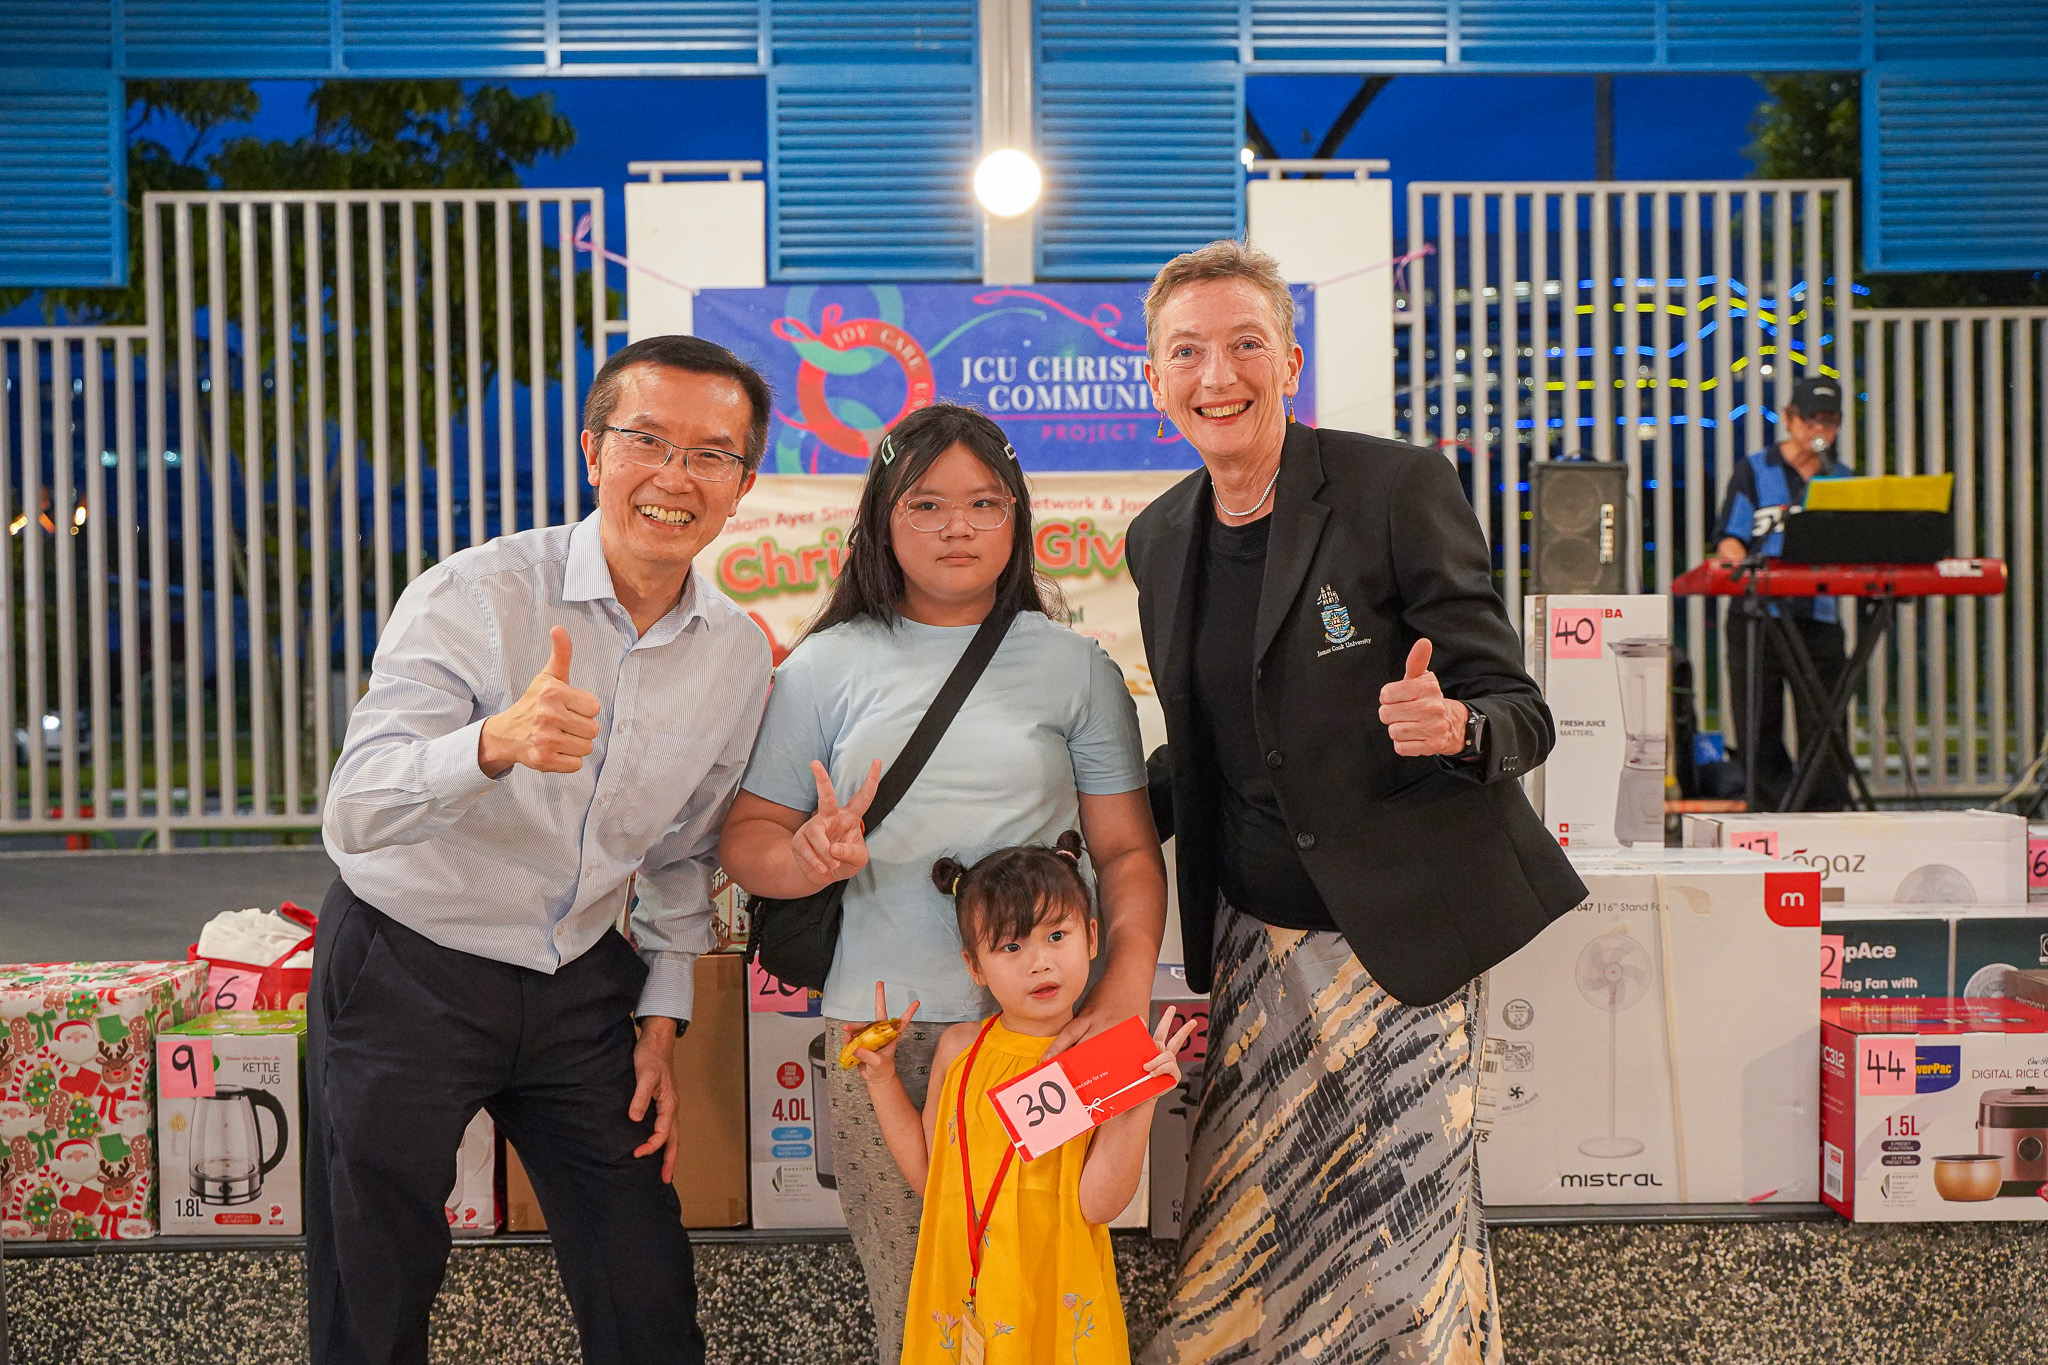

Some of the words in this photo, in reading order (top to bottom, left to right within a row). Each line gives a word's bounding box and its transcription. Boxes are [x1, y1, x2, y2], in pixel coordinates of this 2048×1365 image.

[833, 324, 868, 348] JOY
[880, 328, 924, 370] CARE
[961, 356, 1017, 388] JCU
[1041, 423, 1138, 444] PROJECT
[1030, 496, 1095, 511] etwork
[1102, 498, 1114, 510] &
[723, 516, 770, 535] olam
[775, 511, 814, 532] Ayer
[1555, 617, 1595, 646] 40
[1317, 649, 1331, 657] James
[1332, 643, 1344, 651] Cook
[1345, 638, 1371, 648] University
[1560, 720, 1584, 728] FRESH
[1585, 720, 1606, 728] JUICE
[1620, 902, 1649, 912] Stand
[1840, 942, 1897, 963] pAce
[215, 975, 238, 1010] 6
[1840, 978, 1863, 993] ing
[1865, 977, 1888, 990] Fan
[1891, 976, 1919, 989] with
[172, 1045, 198, 1089] 9
[242, 1062, 280, 1073] KETTLE
[1867, 1049, 1906, 1085] 44
[1972, 1069, 2012, 1079] DIGITAL
[2016, 1069, 2040, 1079] RICE
[260, 1074, 281, 1084] JUG
[772, 1098, 811, 1121] 4.0L
[1016, 1080, 1067, 1128] 30
[1885, 1115, 1920, 1136] 1.5L
[1561, 1172, 1663, 1187] mistral
[175, 1198, 204, 1217] 1.8L
